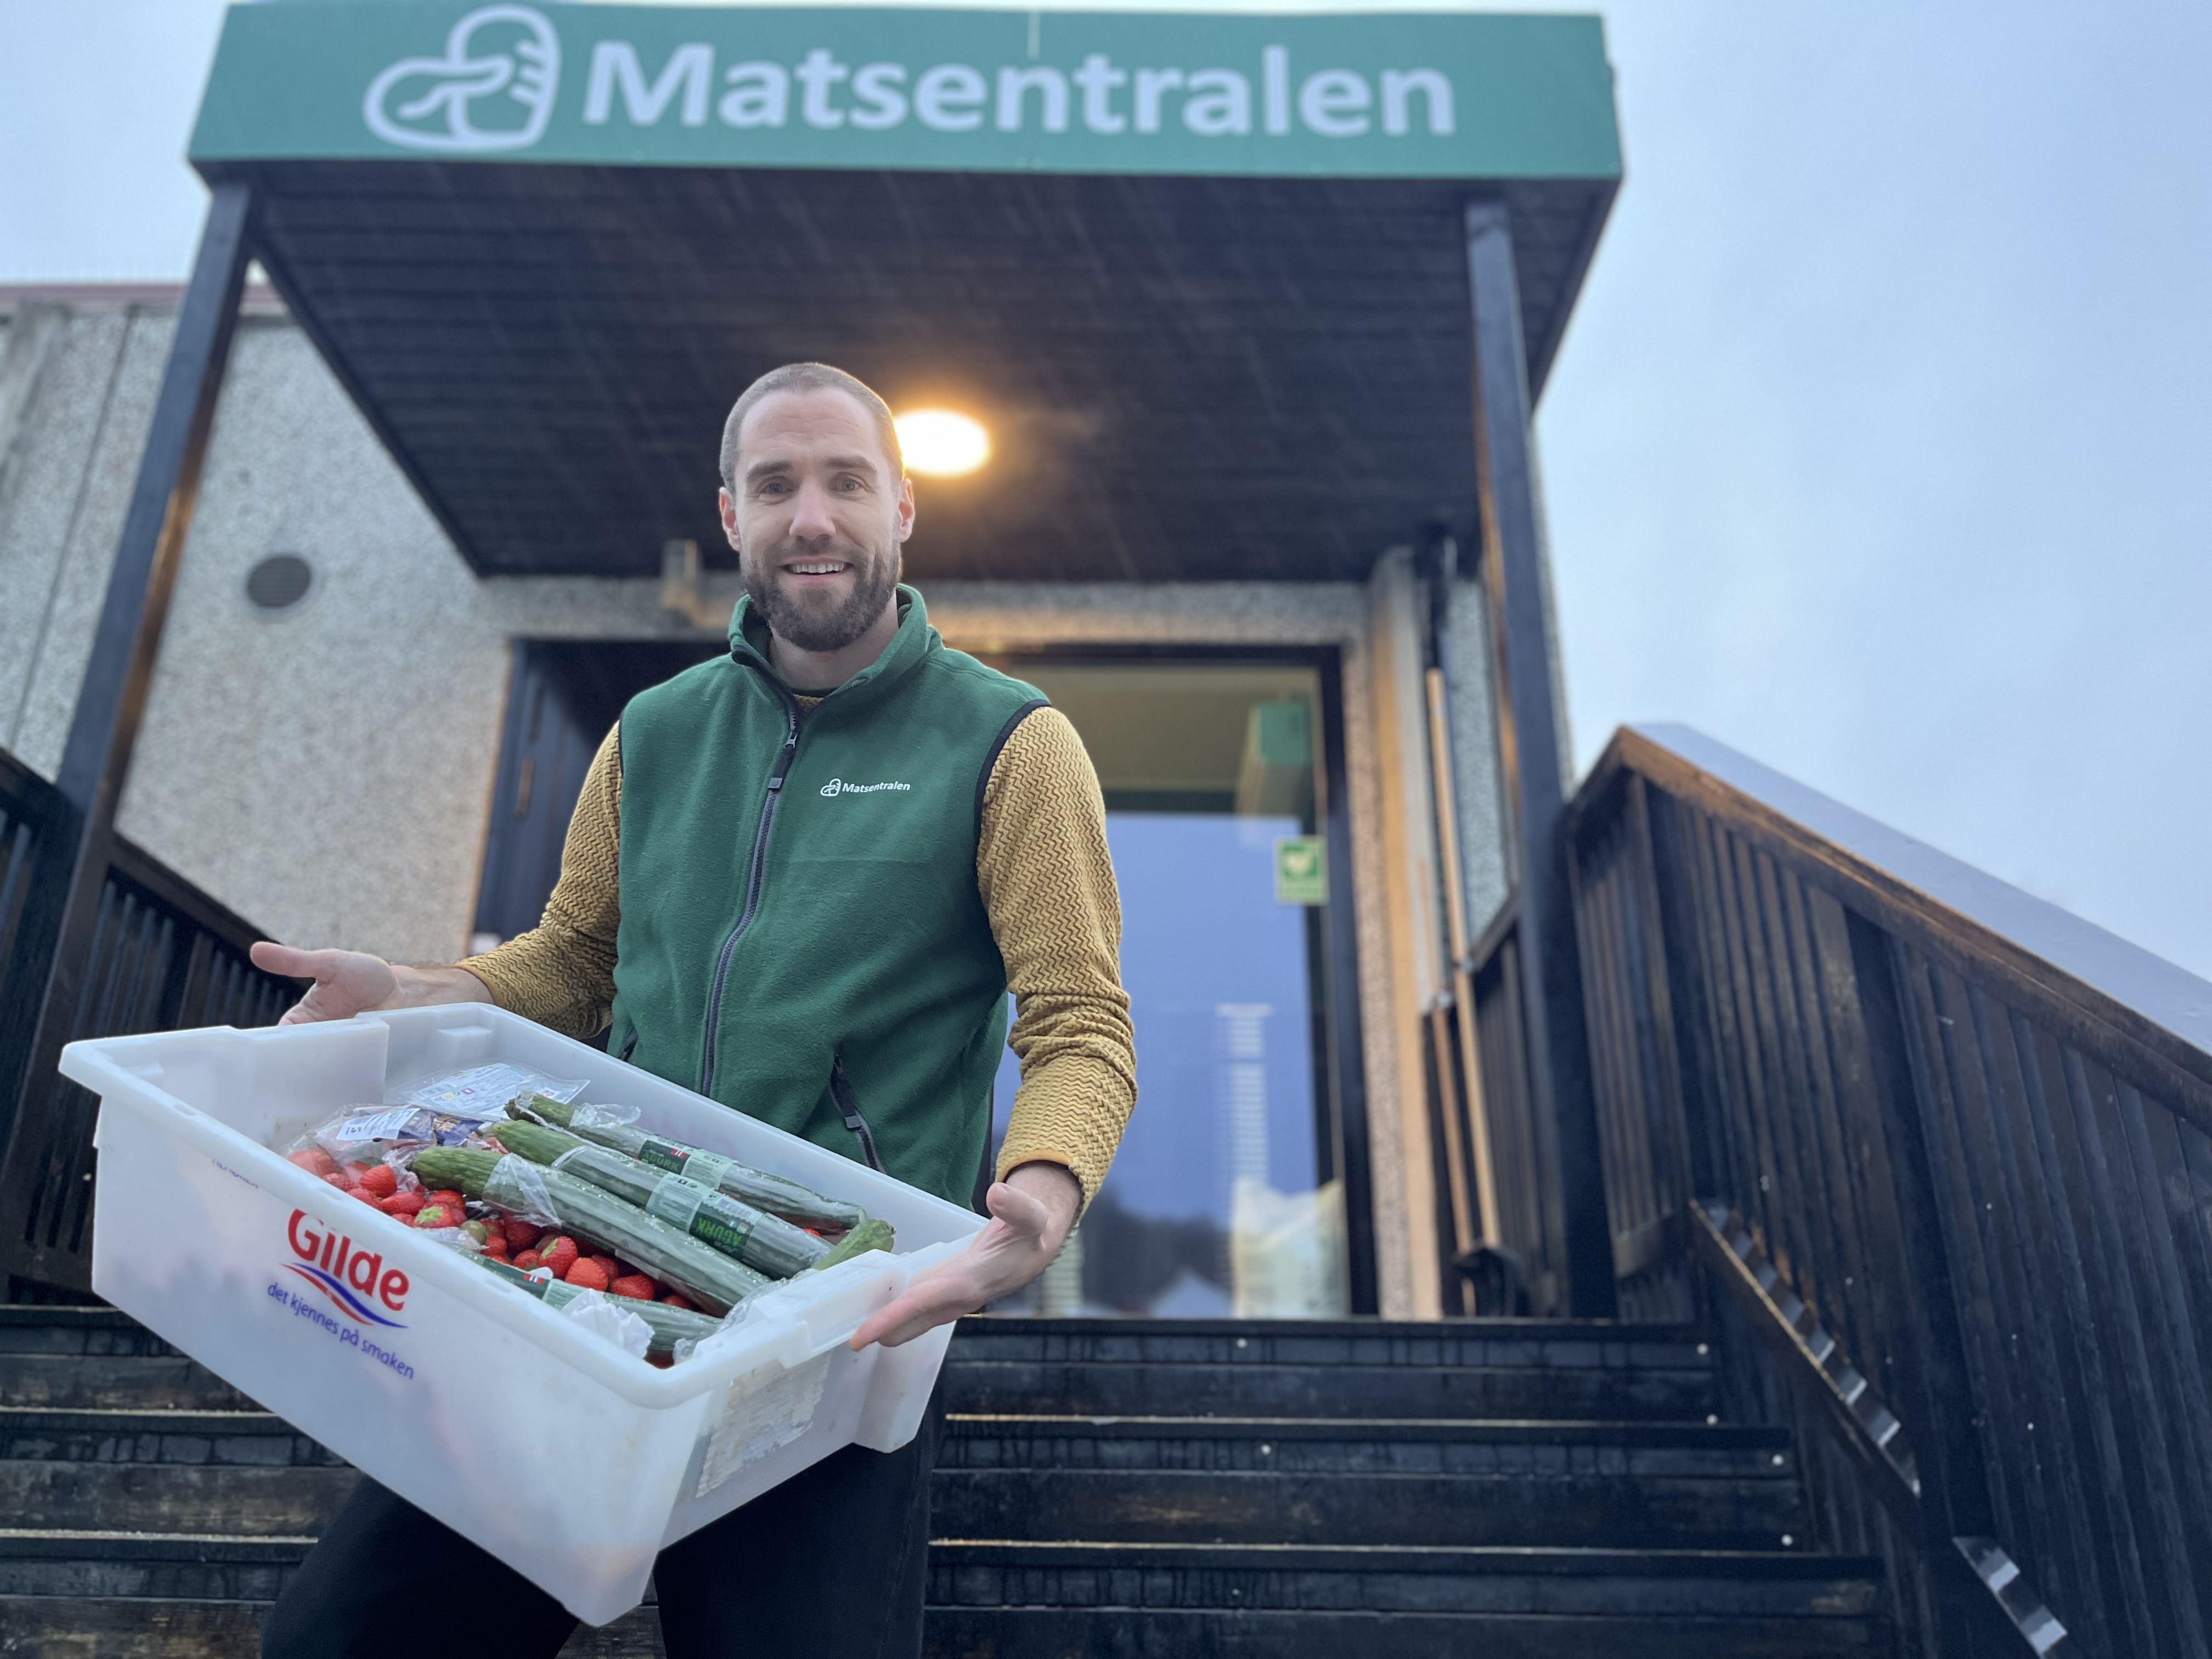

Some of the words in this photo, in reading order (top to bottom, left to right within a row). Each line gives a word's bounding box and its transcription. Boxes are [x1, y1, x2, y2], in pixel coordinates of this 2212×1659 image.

[583, 40, 1455, 137] Matsentralen
[842, 781, 911, 793] Matsentralen
[287, 1208, 410, 1312] Gilde
[267, 1282, 289, 1305] det
[290, 1293, 340, 1334] kjennes
[340, 1328, 359, 1346] på
[362, 1339, 415, 1380] smaken
